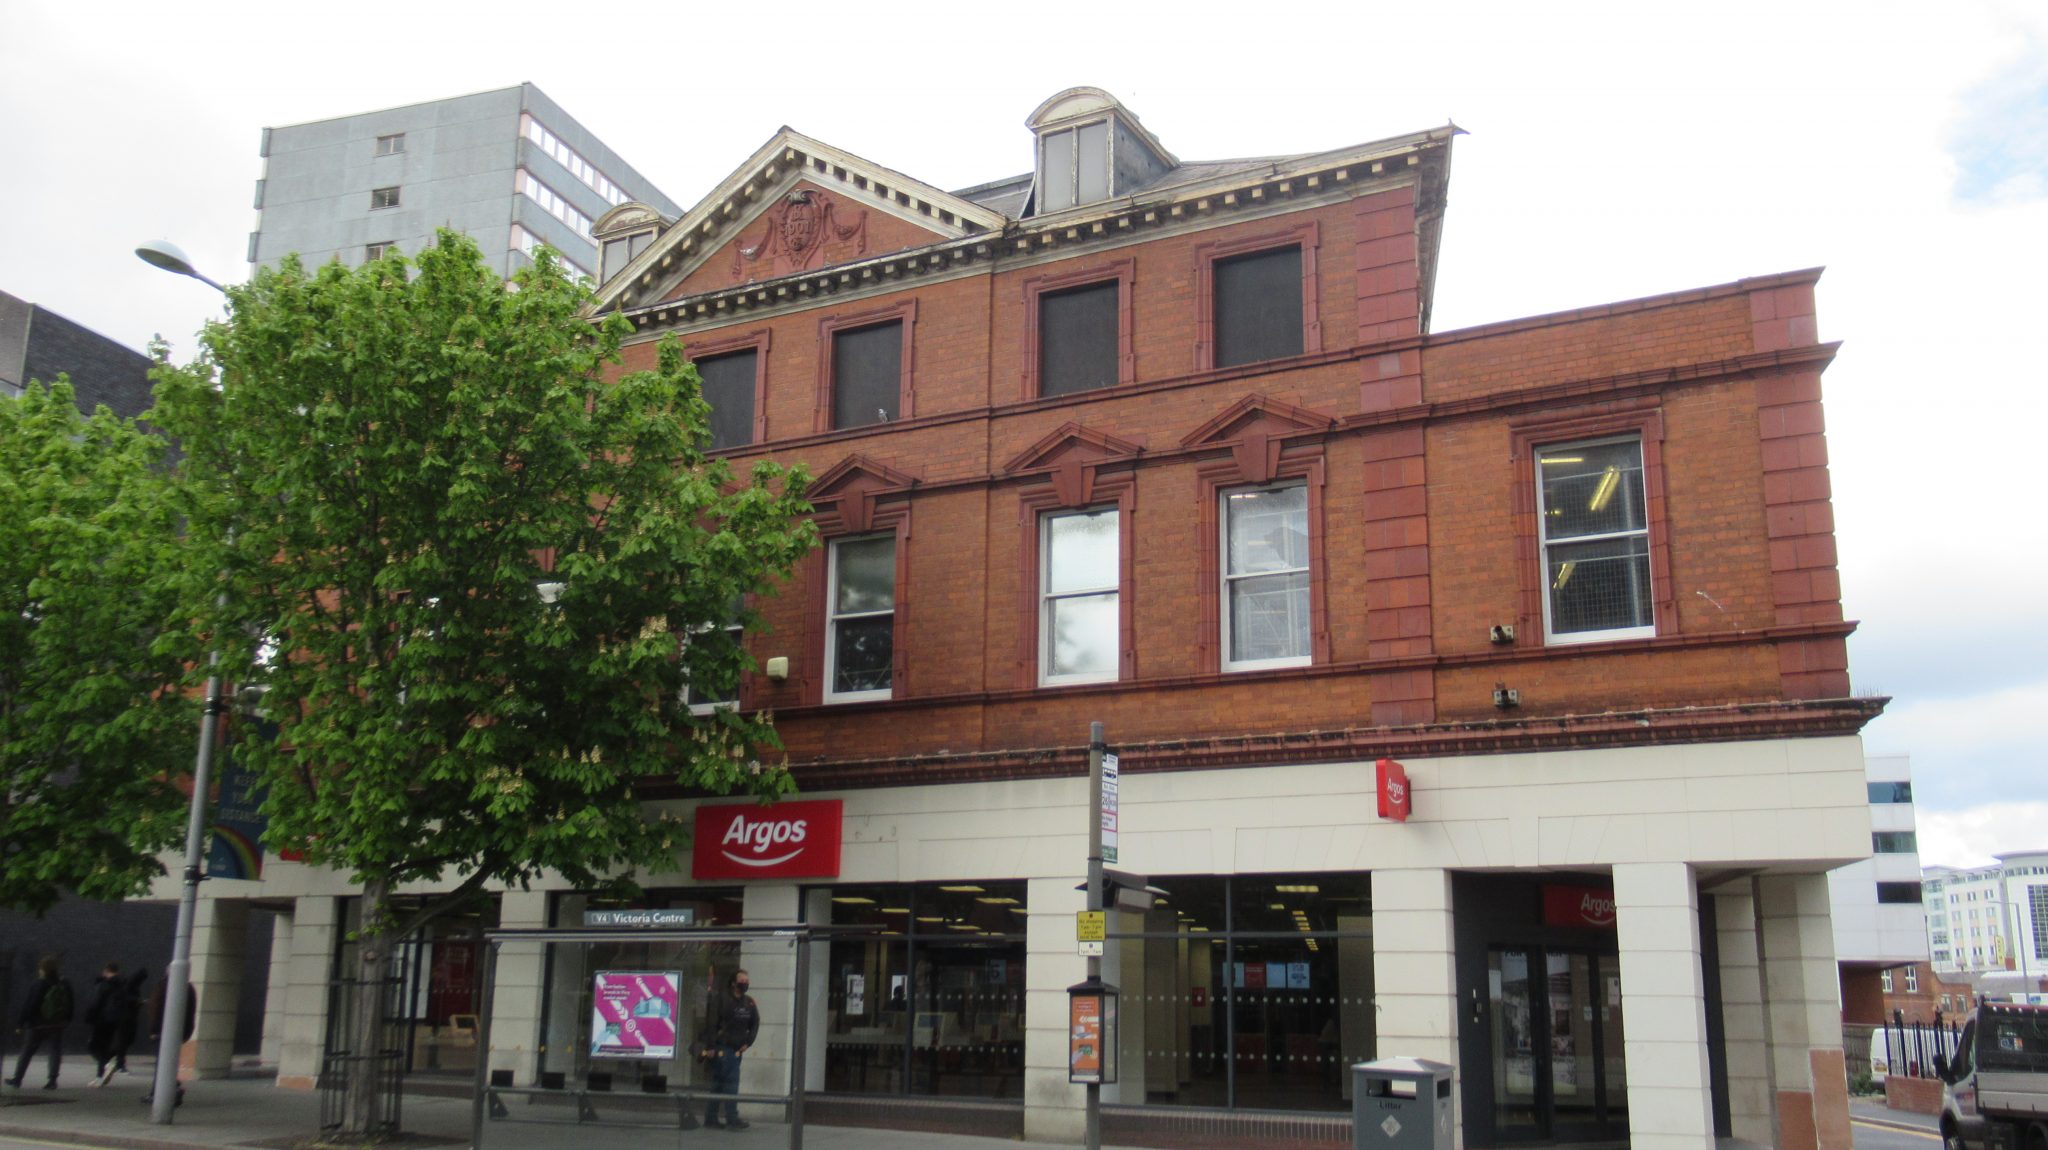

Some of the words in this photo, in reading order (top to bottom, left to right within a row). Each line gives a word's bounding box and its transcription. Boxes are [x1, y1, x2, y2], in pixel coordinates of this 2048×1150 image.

[1387, 777, 1404, 797] Argos
[721, 815, 808, 853] Argos
[1580, 893, 1616, 917] Argos
[613, 912, 650, 923] Victoria
[653, 912, 686, 923] Centre
